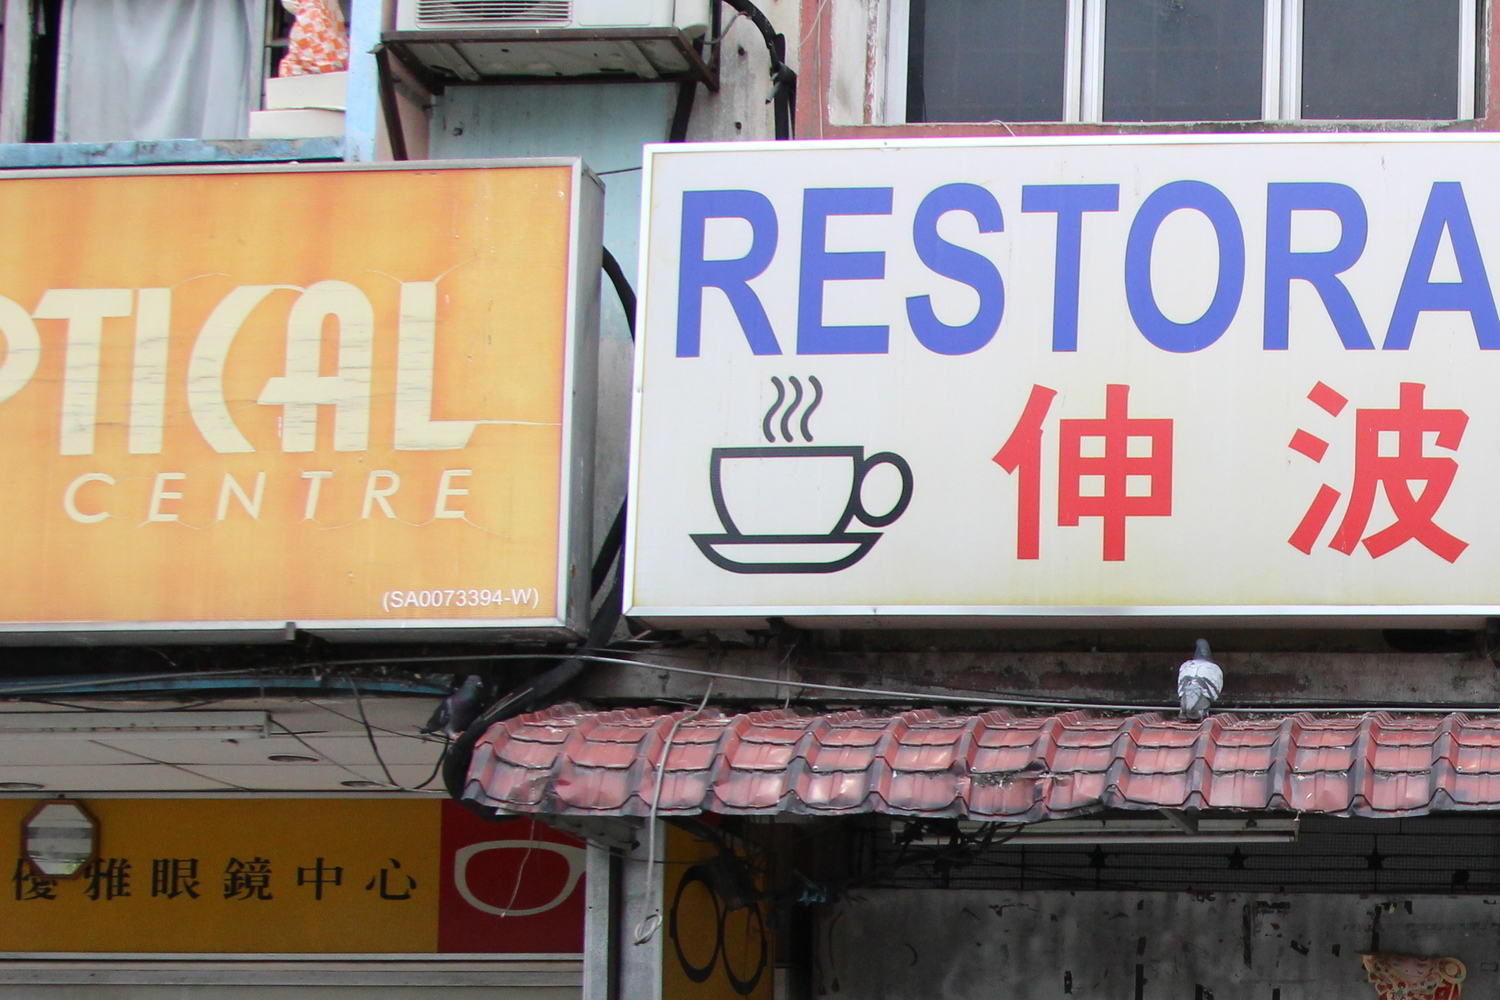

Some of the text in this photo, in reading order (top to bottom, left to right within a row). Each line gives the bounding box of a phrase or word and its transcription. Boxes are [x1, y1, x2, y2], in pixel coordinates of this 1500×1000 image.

[63, 469, 473, 524] CENTRE
[382, 588, 539, 613] (SA0073394-W)
[12, 856, 418, 901] 優雅眼鏡中心
